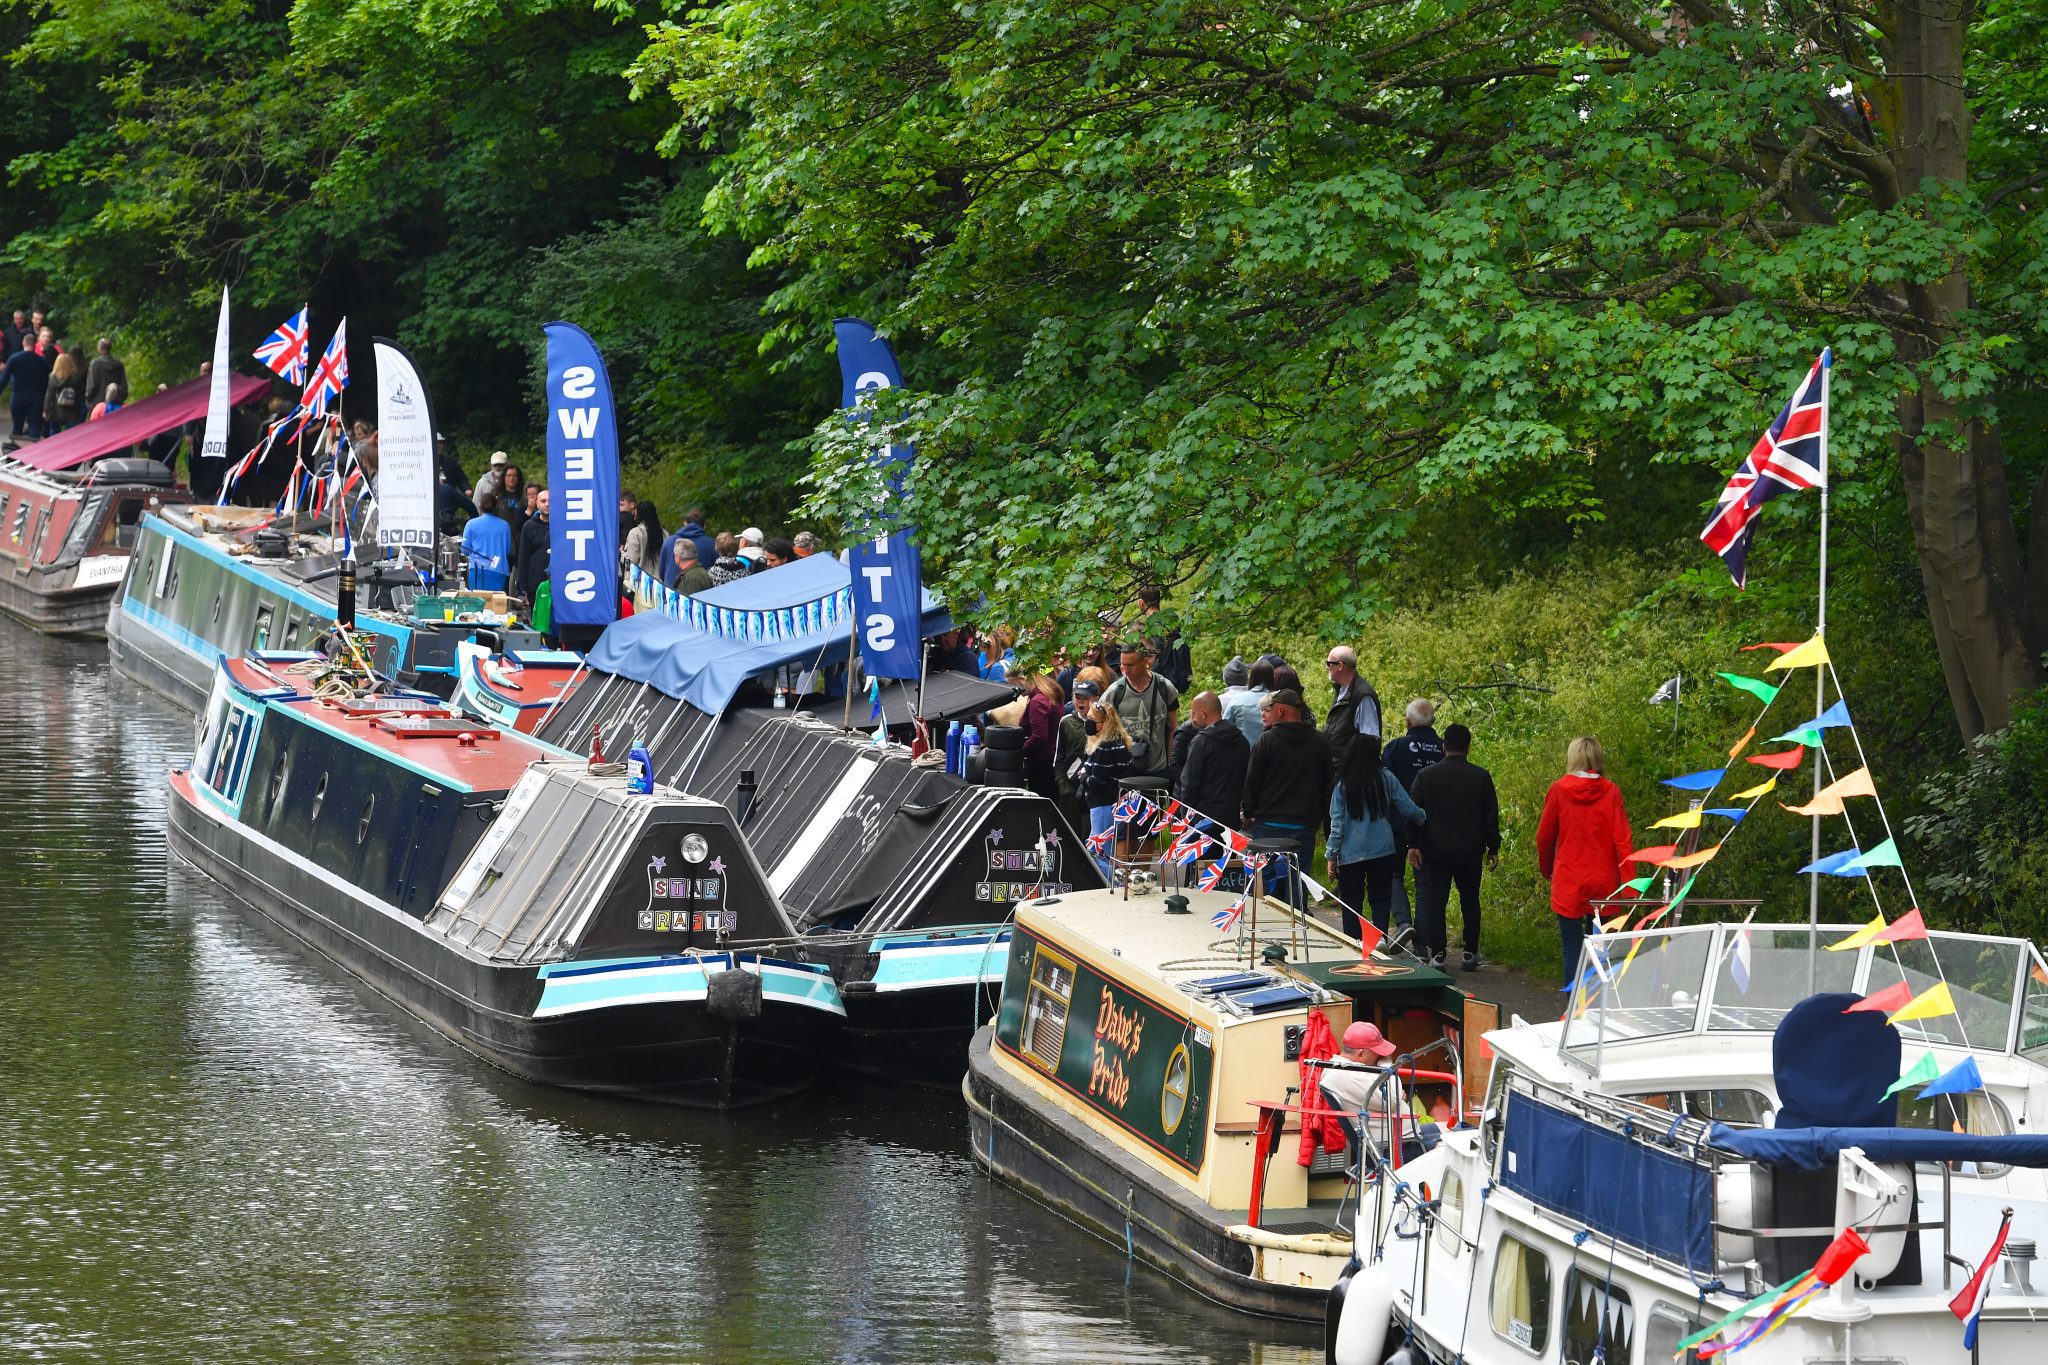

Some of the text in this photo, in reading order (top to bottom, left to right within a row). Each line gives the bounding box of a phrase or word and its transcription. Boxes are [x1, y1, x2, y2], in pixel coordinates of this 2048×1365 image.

[991, 850, 1055, 871] STAR
[653, 879, 719, 899] STAR
[638, 910, 737, 931] CRAFTS
[1095, 984, 1145, 1062] Dave's
[1088, 1038, 1130, 1111] Pride
